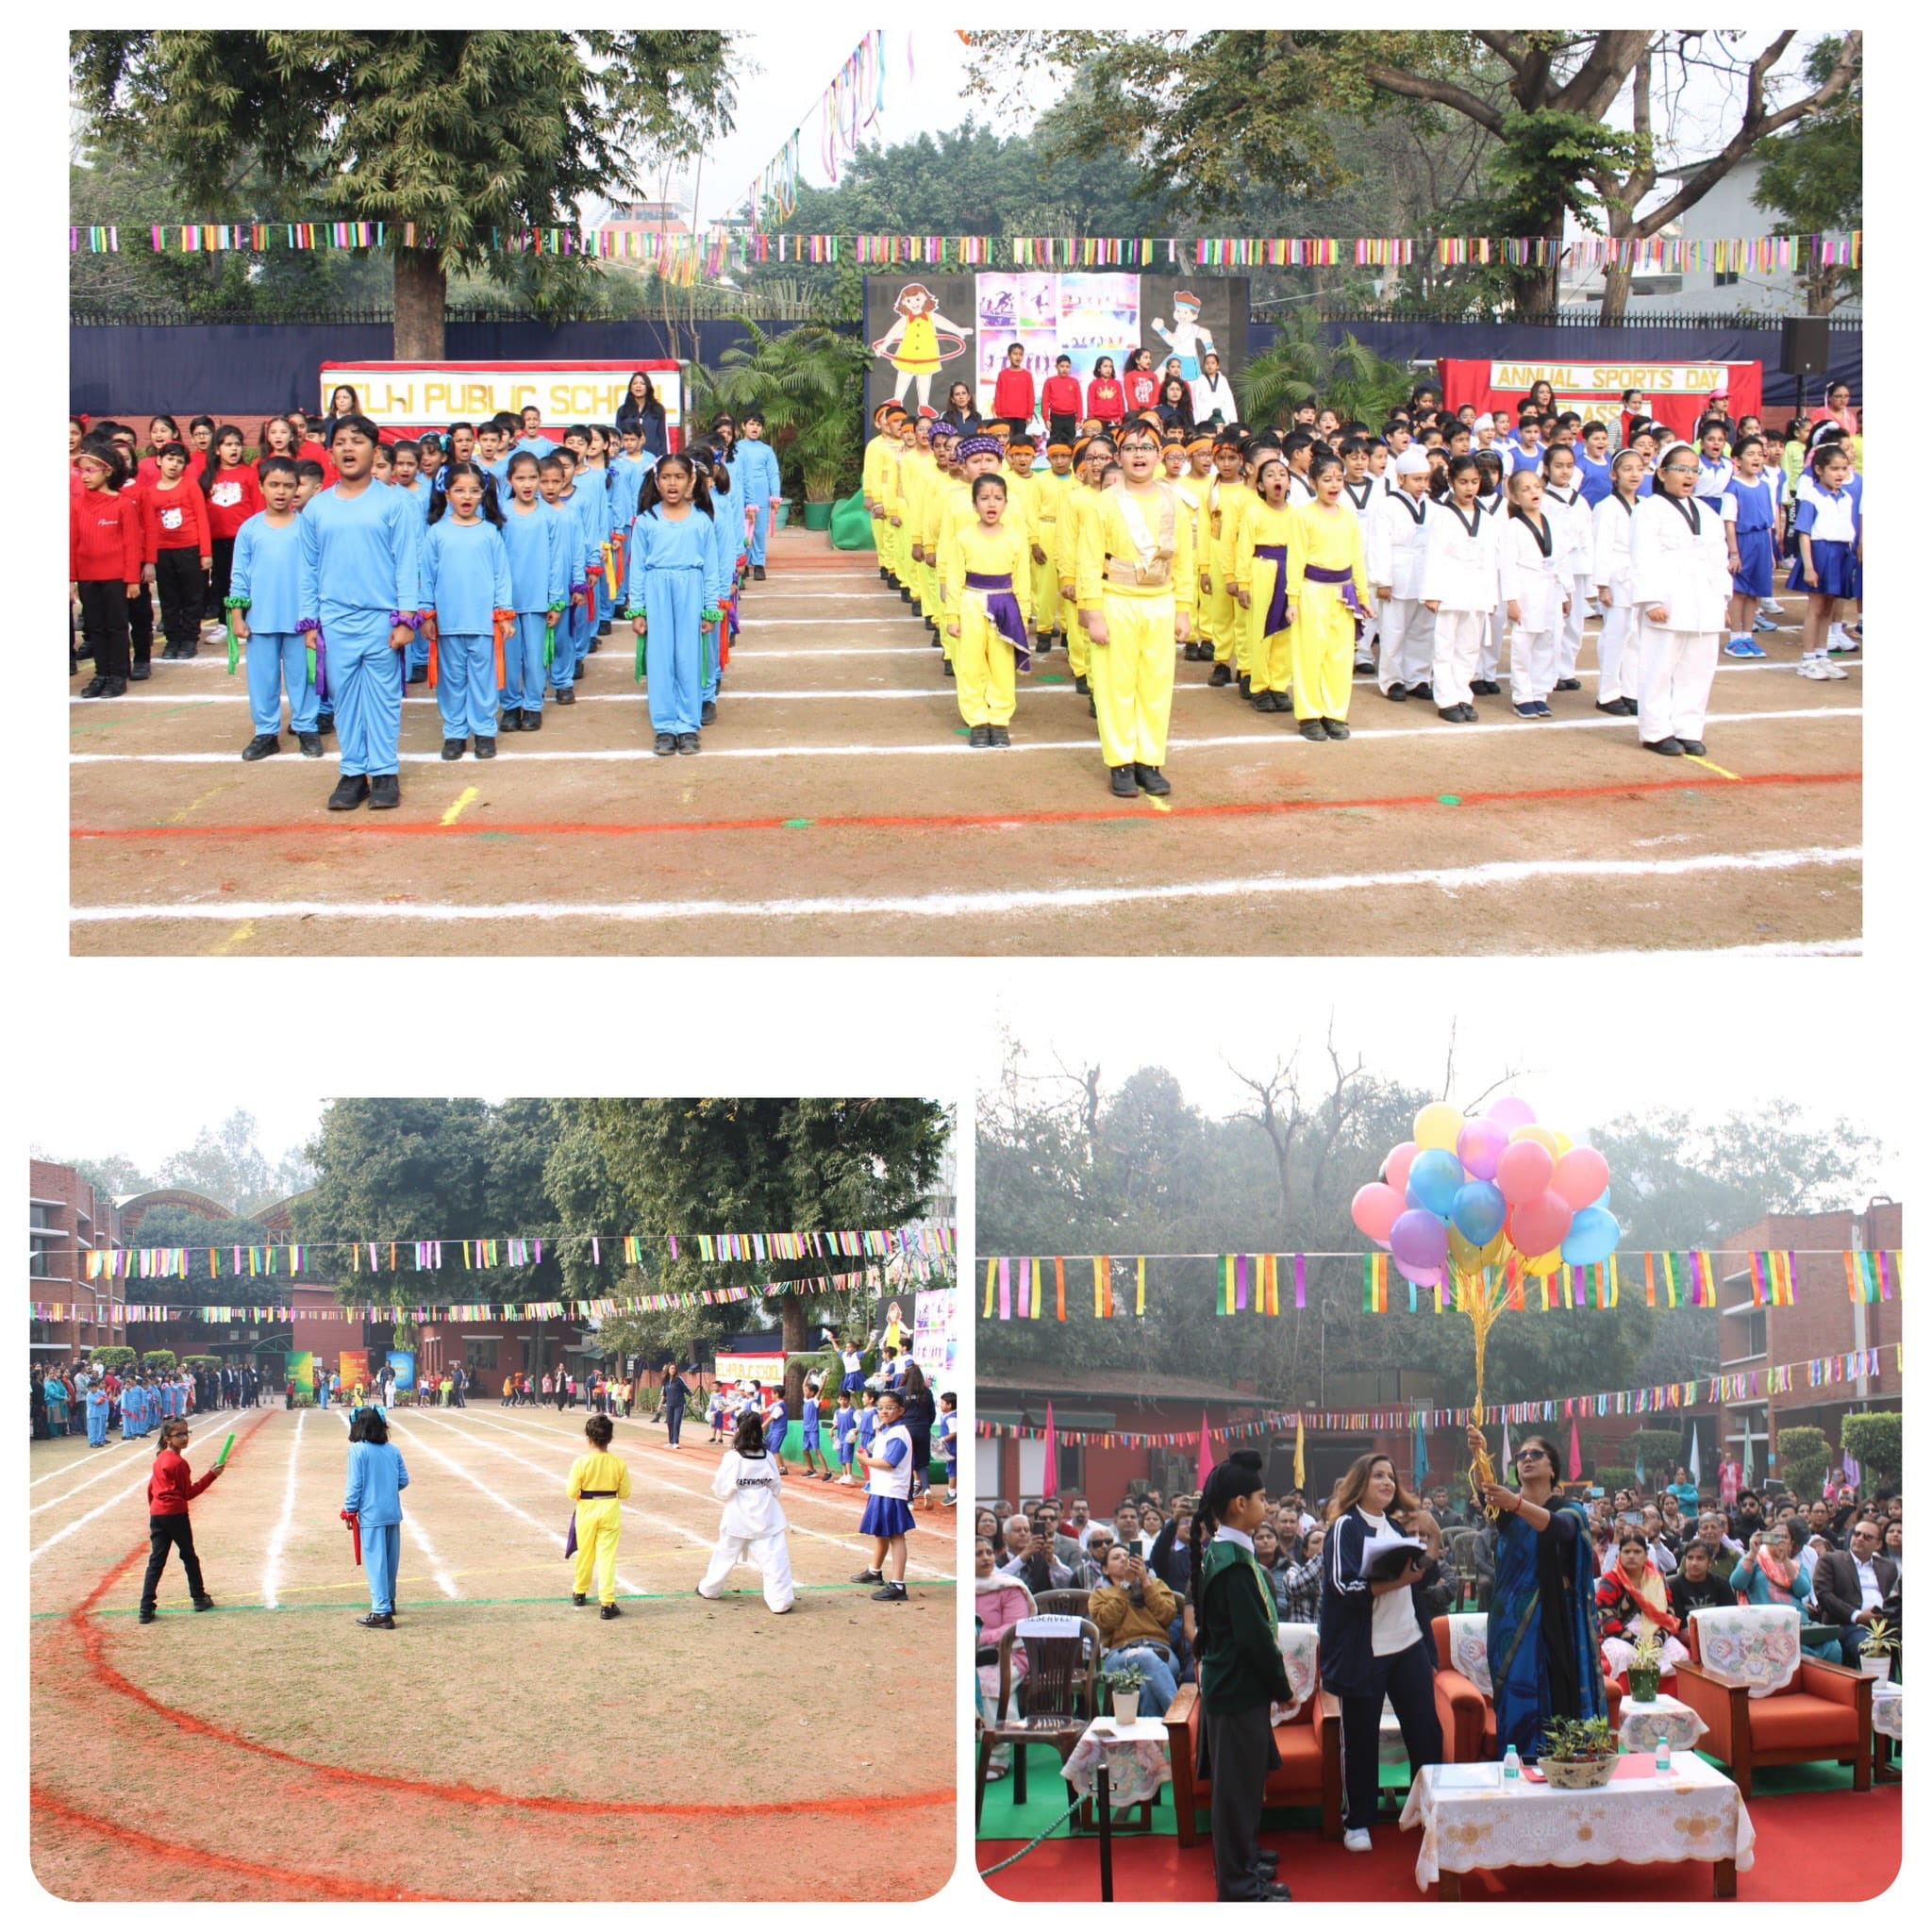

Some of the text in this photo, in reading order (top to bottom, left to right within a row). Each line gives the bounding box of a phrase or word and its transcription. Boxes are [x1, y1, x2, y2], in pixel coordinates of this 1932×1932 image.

[1497, 366, 1722, 390] ANNUAL SPORTS DAY
[425, 383, 537, 415] PUBLIC
[549, 384, 677, 416] SCHOL
